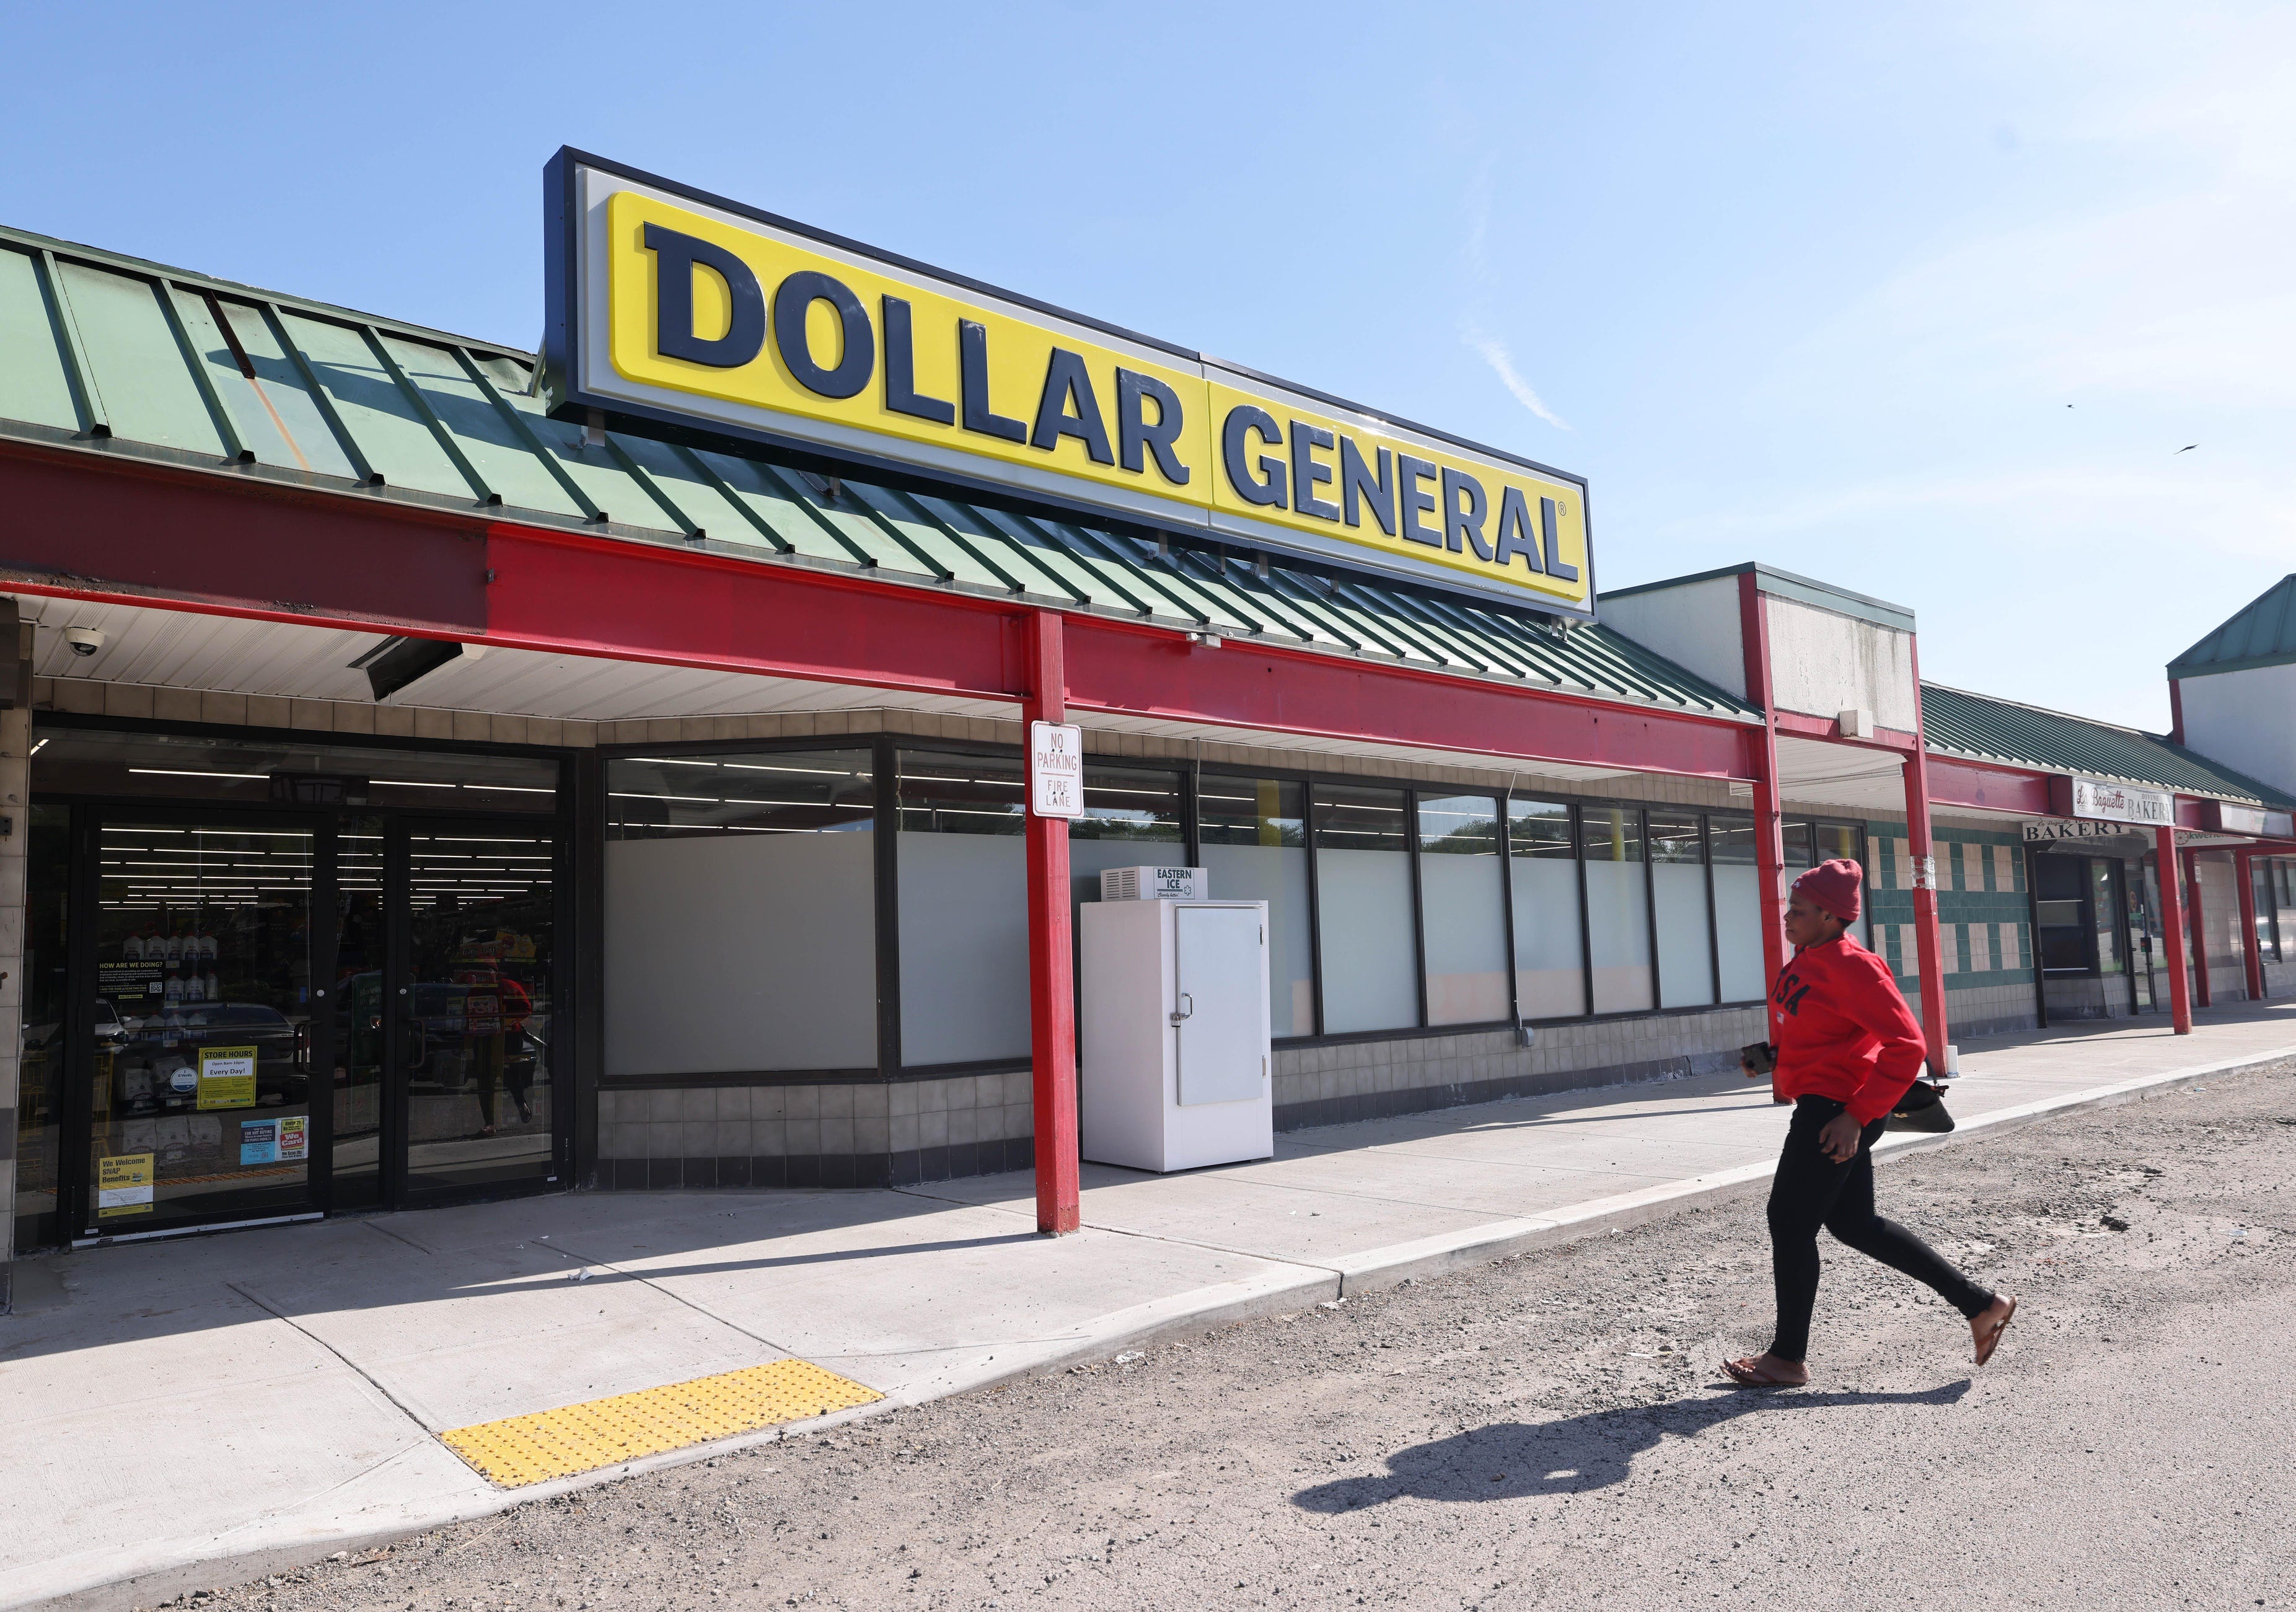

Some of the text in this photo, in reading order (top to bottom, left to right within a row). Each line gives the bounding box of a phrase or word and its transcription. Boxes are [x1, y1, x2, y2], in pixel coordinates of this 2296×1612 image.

[643, 221, 1578, 583] DOLLAR GENERAL
[1051, 733, 1063, 749] NO
[1037, 752, 1077, 771] PARKING
[1047, 780, 1068, 792] FIRE
[1046, 795, 1071, 808] LANE
[2091, 788, 2124, 813] Baguette
[2142, 793, 2160, 801] DIVINE
[2127, 799, 2171, 821] BAKERY
[2026, 822, 2122, 840] BAKERY
[1158, 869, 1192, 879] EASTERN
[1167, 879, 1180, 889] ICE
[282, 1138, 302, 1147] Card
[103, 1175, 130, 1183] Benefits
